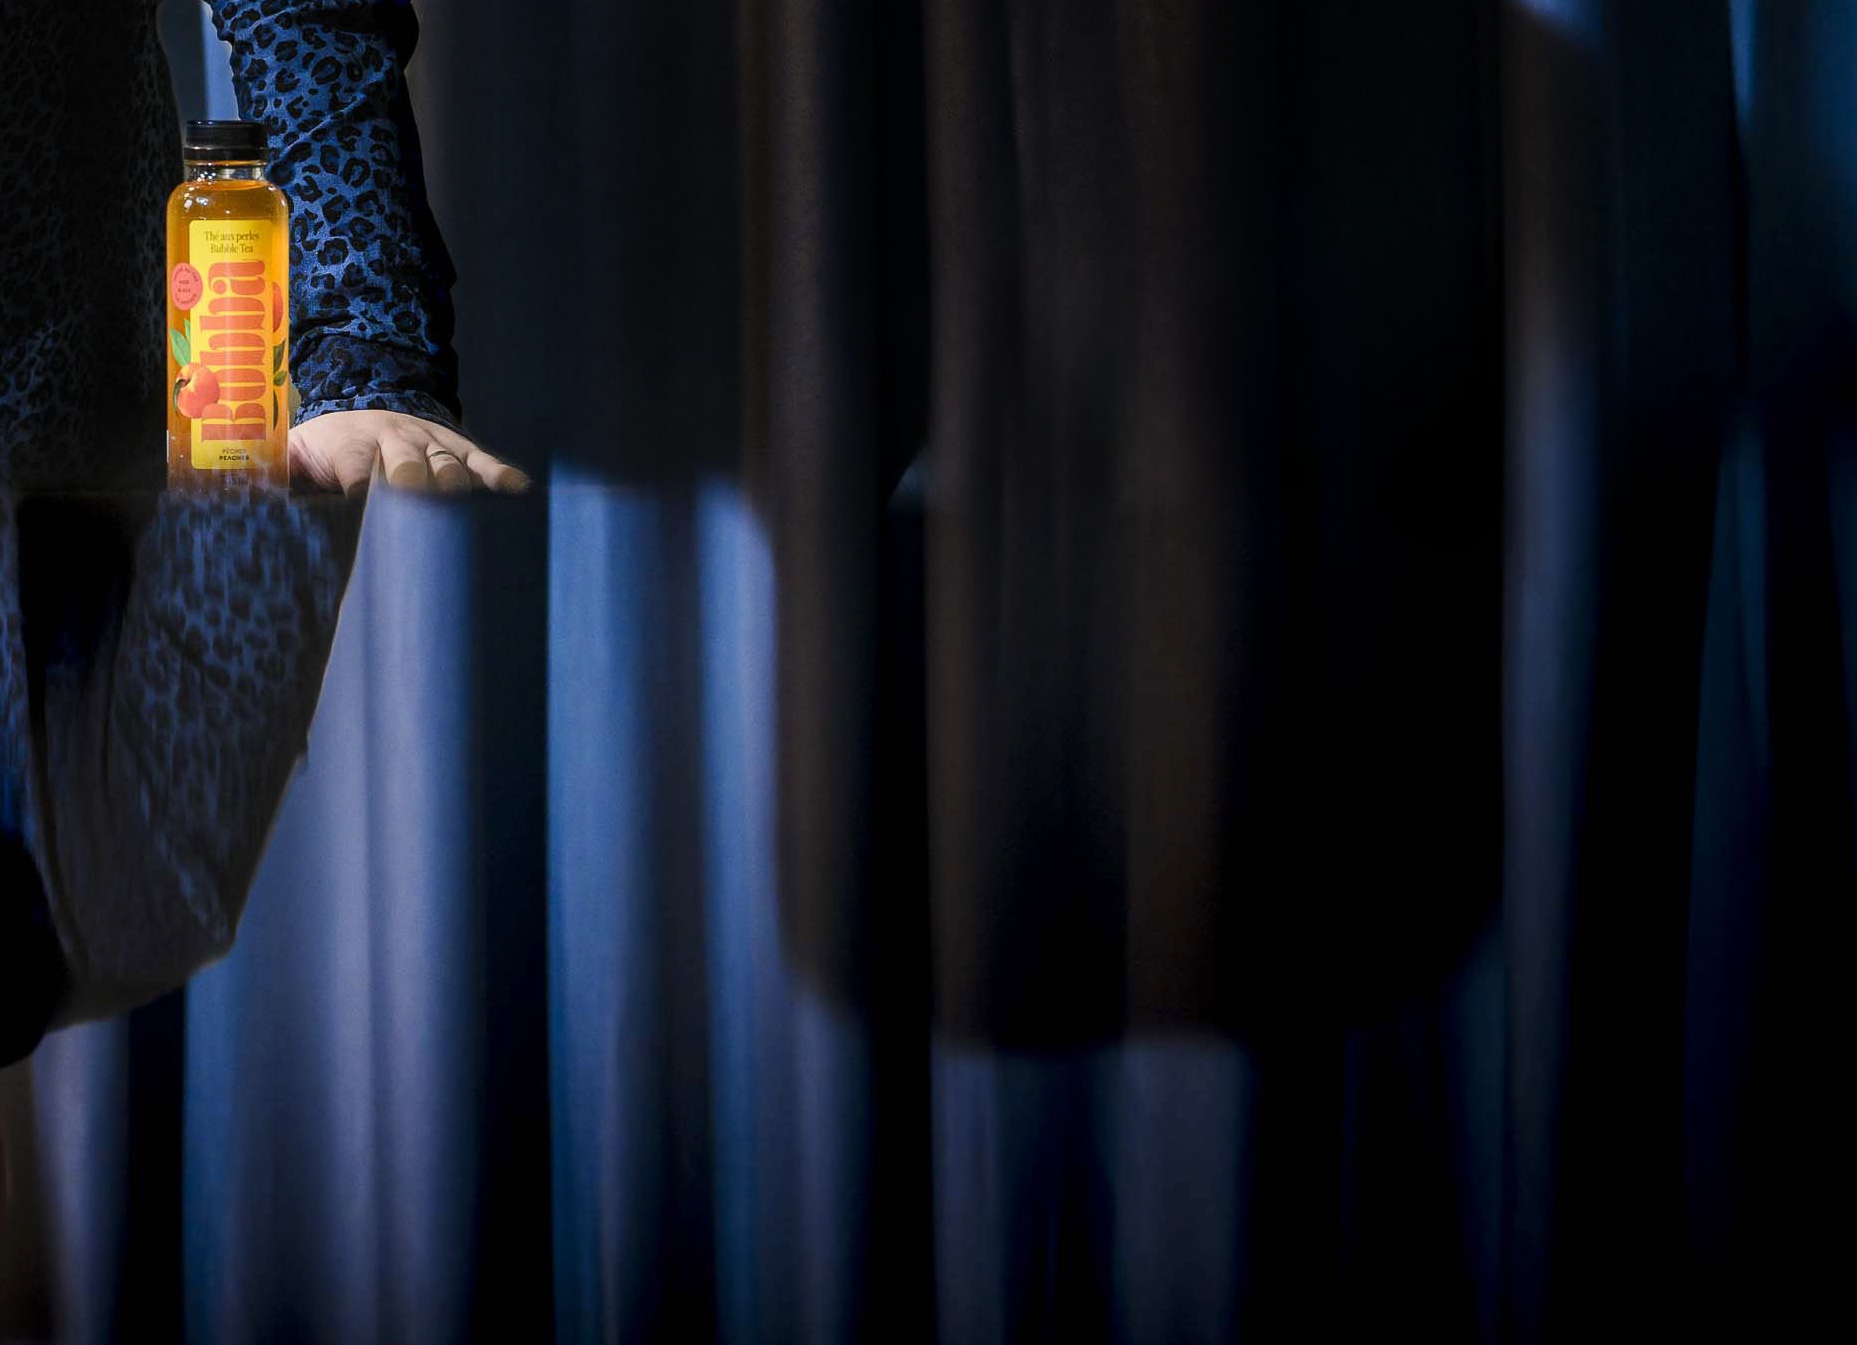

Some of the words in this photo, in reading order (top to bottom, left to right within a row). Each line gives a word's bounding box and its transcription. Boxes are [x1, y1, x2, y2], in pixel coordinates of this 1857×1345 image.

[204, 230, 220, 241] Thé
[235, 230, 260, 243] perles
[210, 243, 239, 253] Bubble
[240, 244, 254, 253] Tea
[199, 260, 266, 442] Bobba
